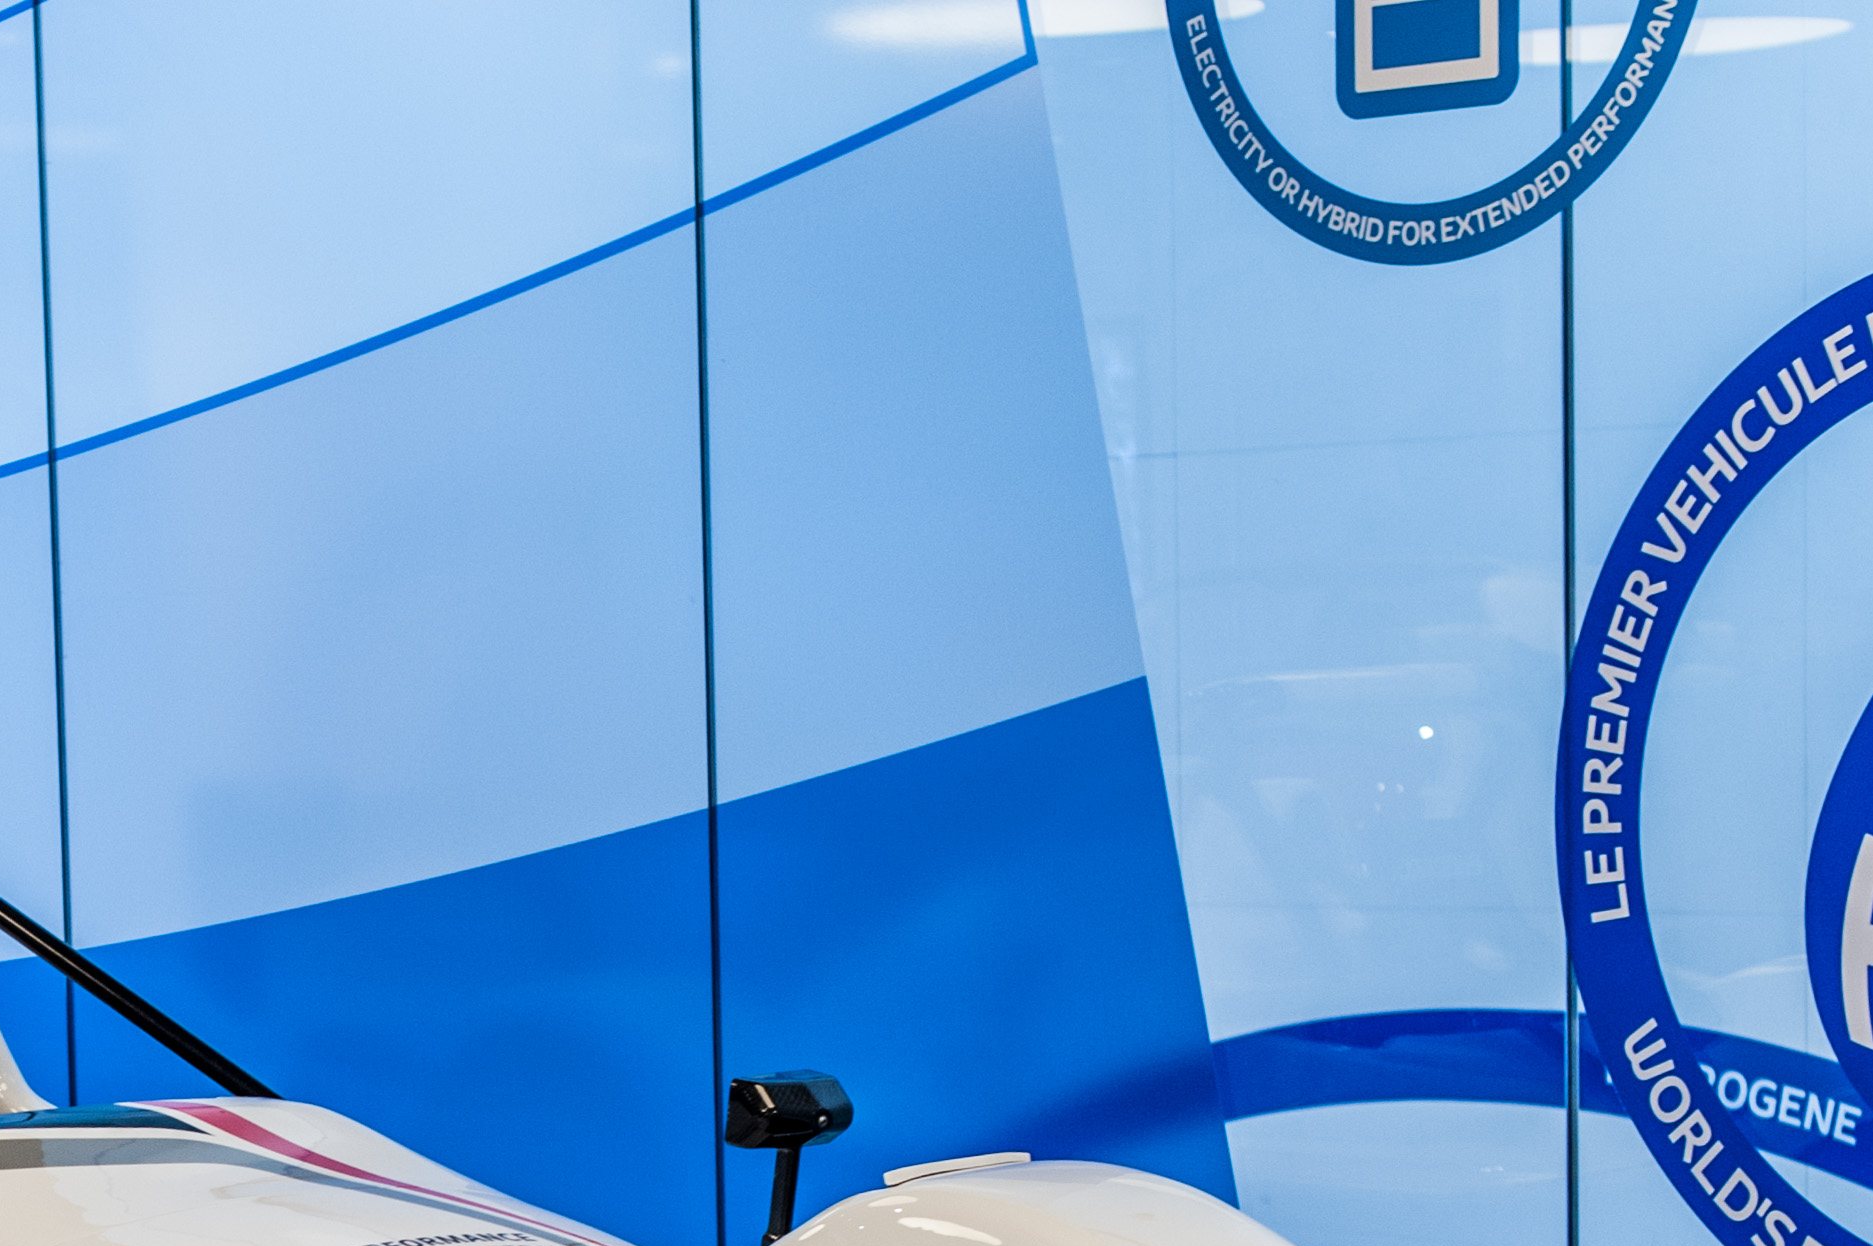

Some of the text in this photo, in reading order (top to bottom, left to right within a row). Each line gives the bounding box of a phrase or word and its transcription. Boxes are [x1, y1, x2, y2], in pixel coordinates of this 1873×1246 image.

[1186, 14, 1273, 173] ELECTRICITY
[1268, 167, 1300, 205] OR
[1298, 189, 1384, 243] HYBRID
[1387, 220, 1437, 246] FOR
[1440, 160, 1571, 244] EXTENDED
[1582, 324, 1868, 923] LE PREMIER VEHICULE
